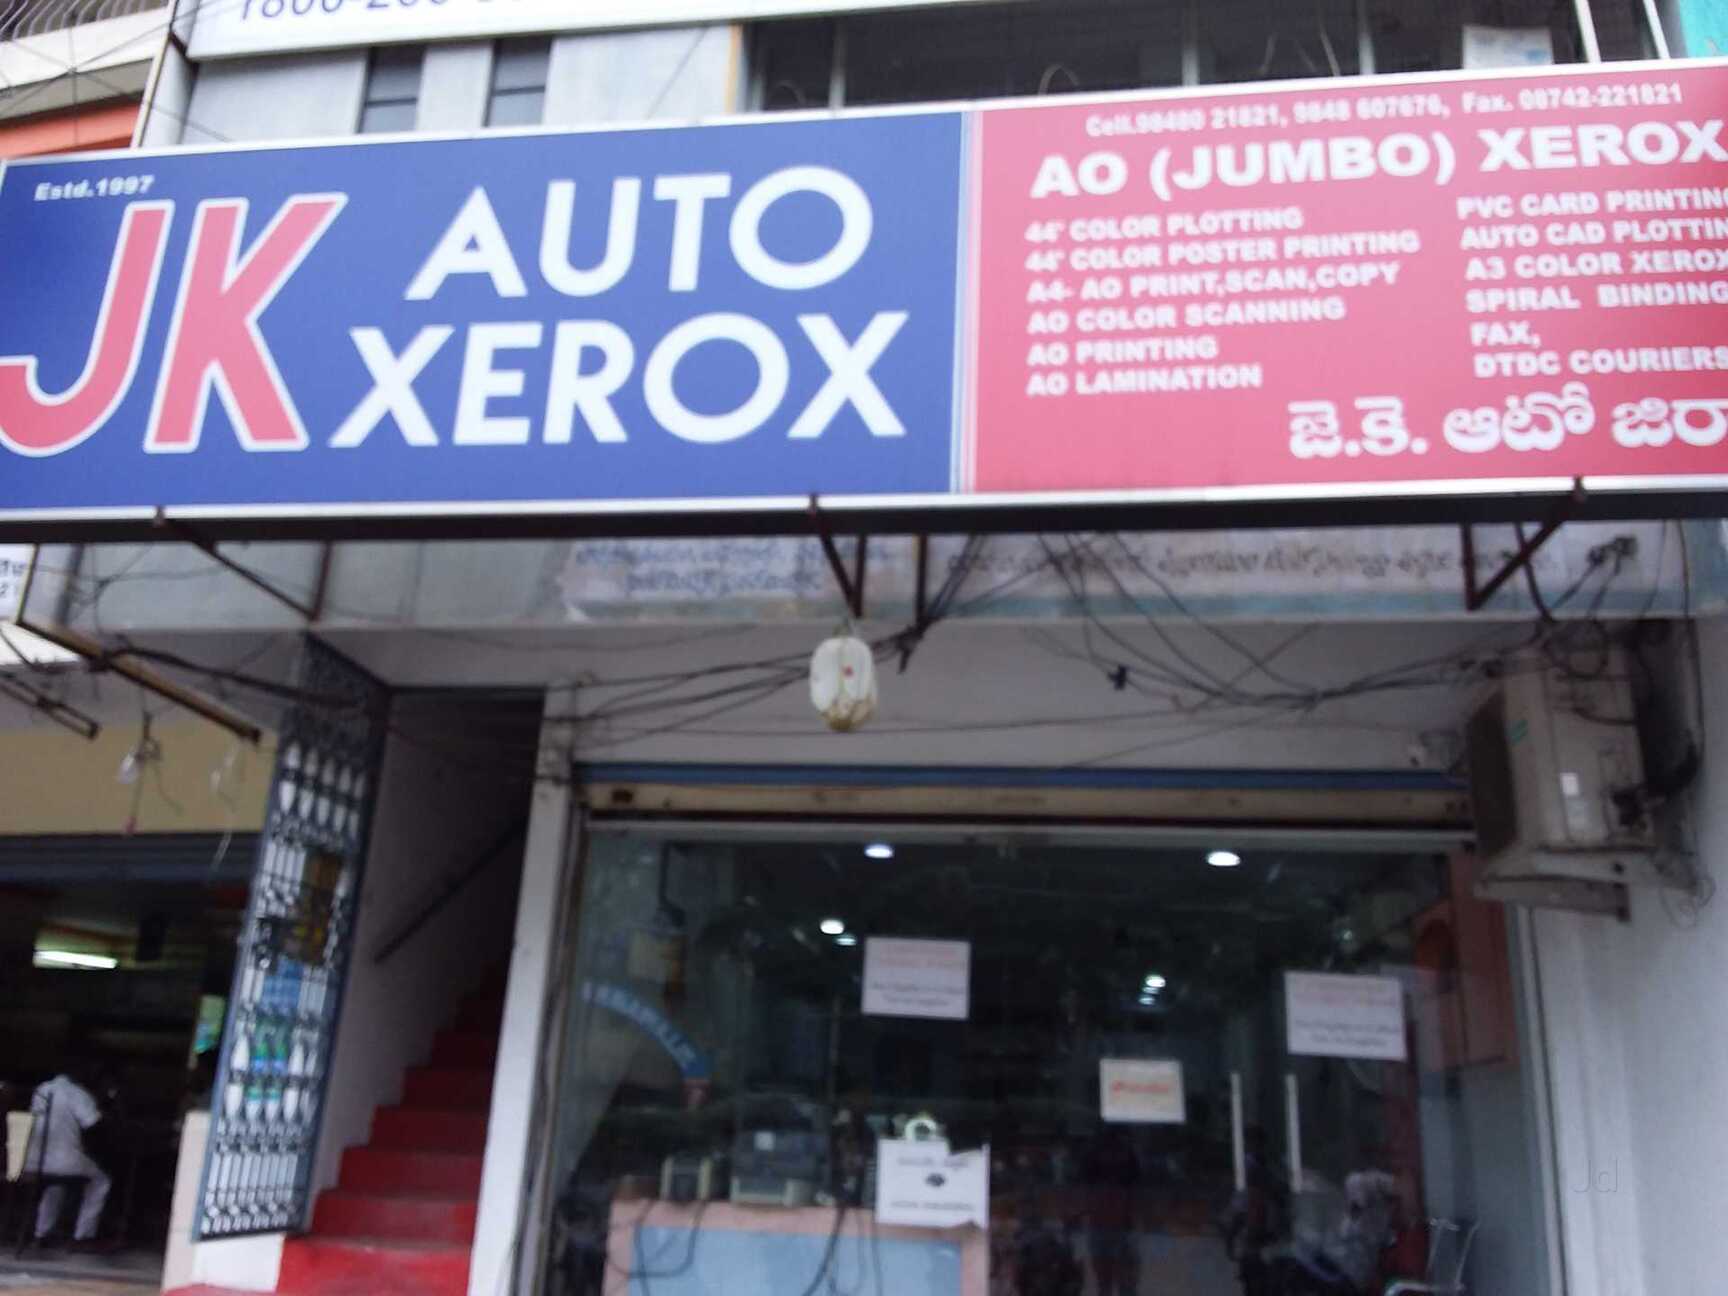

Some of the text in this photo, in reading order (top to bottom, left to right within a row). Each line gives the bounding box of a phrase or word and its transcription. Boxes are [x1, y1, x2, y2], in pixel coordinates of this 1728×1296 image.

[1461, 91, 1514, 113] Fax.
[1030, 120, 1728, 201] AO (JUMBO) XEROX
[35, 173, 155, 201] Estd.1997
[1456, 186, 1728, 220] PVC CARD PRINTIN
[404, 165, 874, 300] AUTO
[1069, 214, 1160, 242] COLOR
[1166, 207, 1304, 236] PLOTTING
[1460, 224, 1539, 250] AUTO
[1545, 220, 1606, 245] CAD
[1069, 243, 1162, 271] COLOR
[1167, 236, 1277, 266] POSTER
[1283, 230, 1421, 257] PRINTING
[1465, 256, 1505, 281] A3
[1514, 251, 1622, 278] COLOR
[1080, 276, 1123, 301] AO
[1129, 262, 1401, 298] PRINT,SCAN,COPY
[1465, 280, 1728, 314] SPIRAL BINDING
[0, 192, 348, 457] JK
[1027, 296, 1346, 334] AO COLOR SCANNING
[1026, 335, 1220, 366] AO PRINTING
[1470, 321, 1541, 348] FAX,
[328, 311, 910, 448] XEROX
[1026, 363, 1263, 396] AO LAMINATION
[1473, 350, 1561, 379] DTDC
